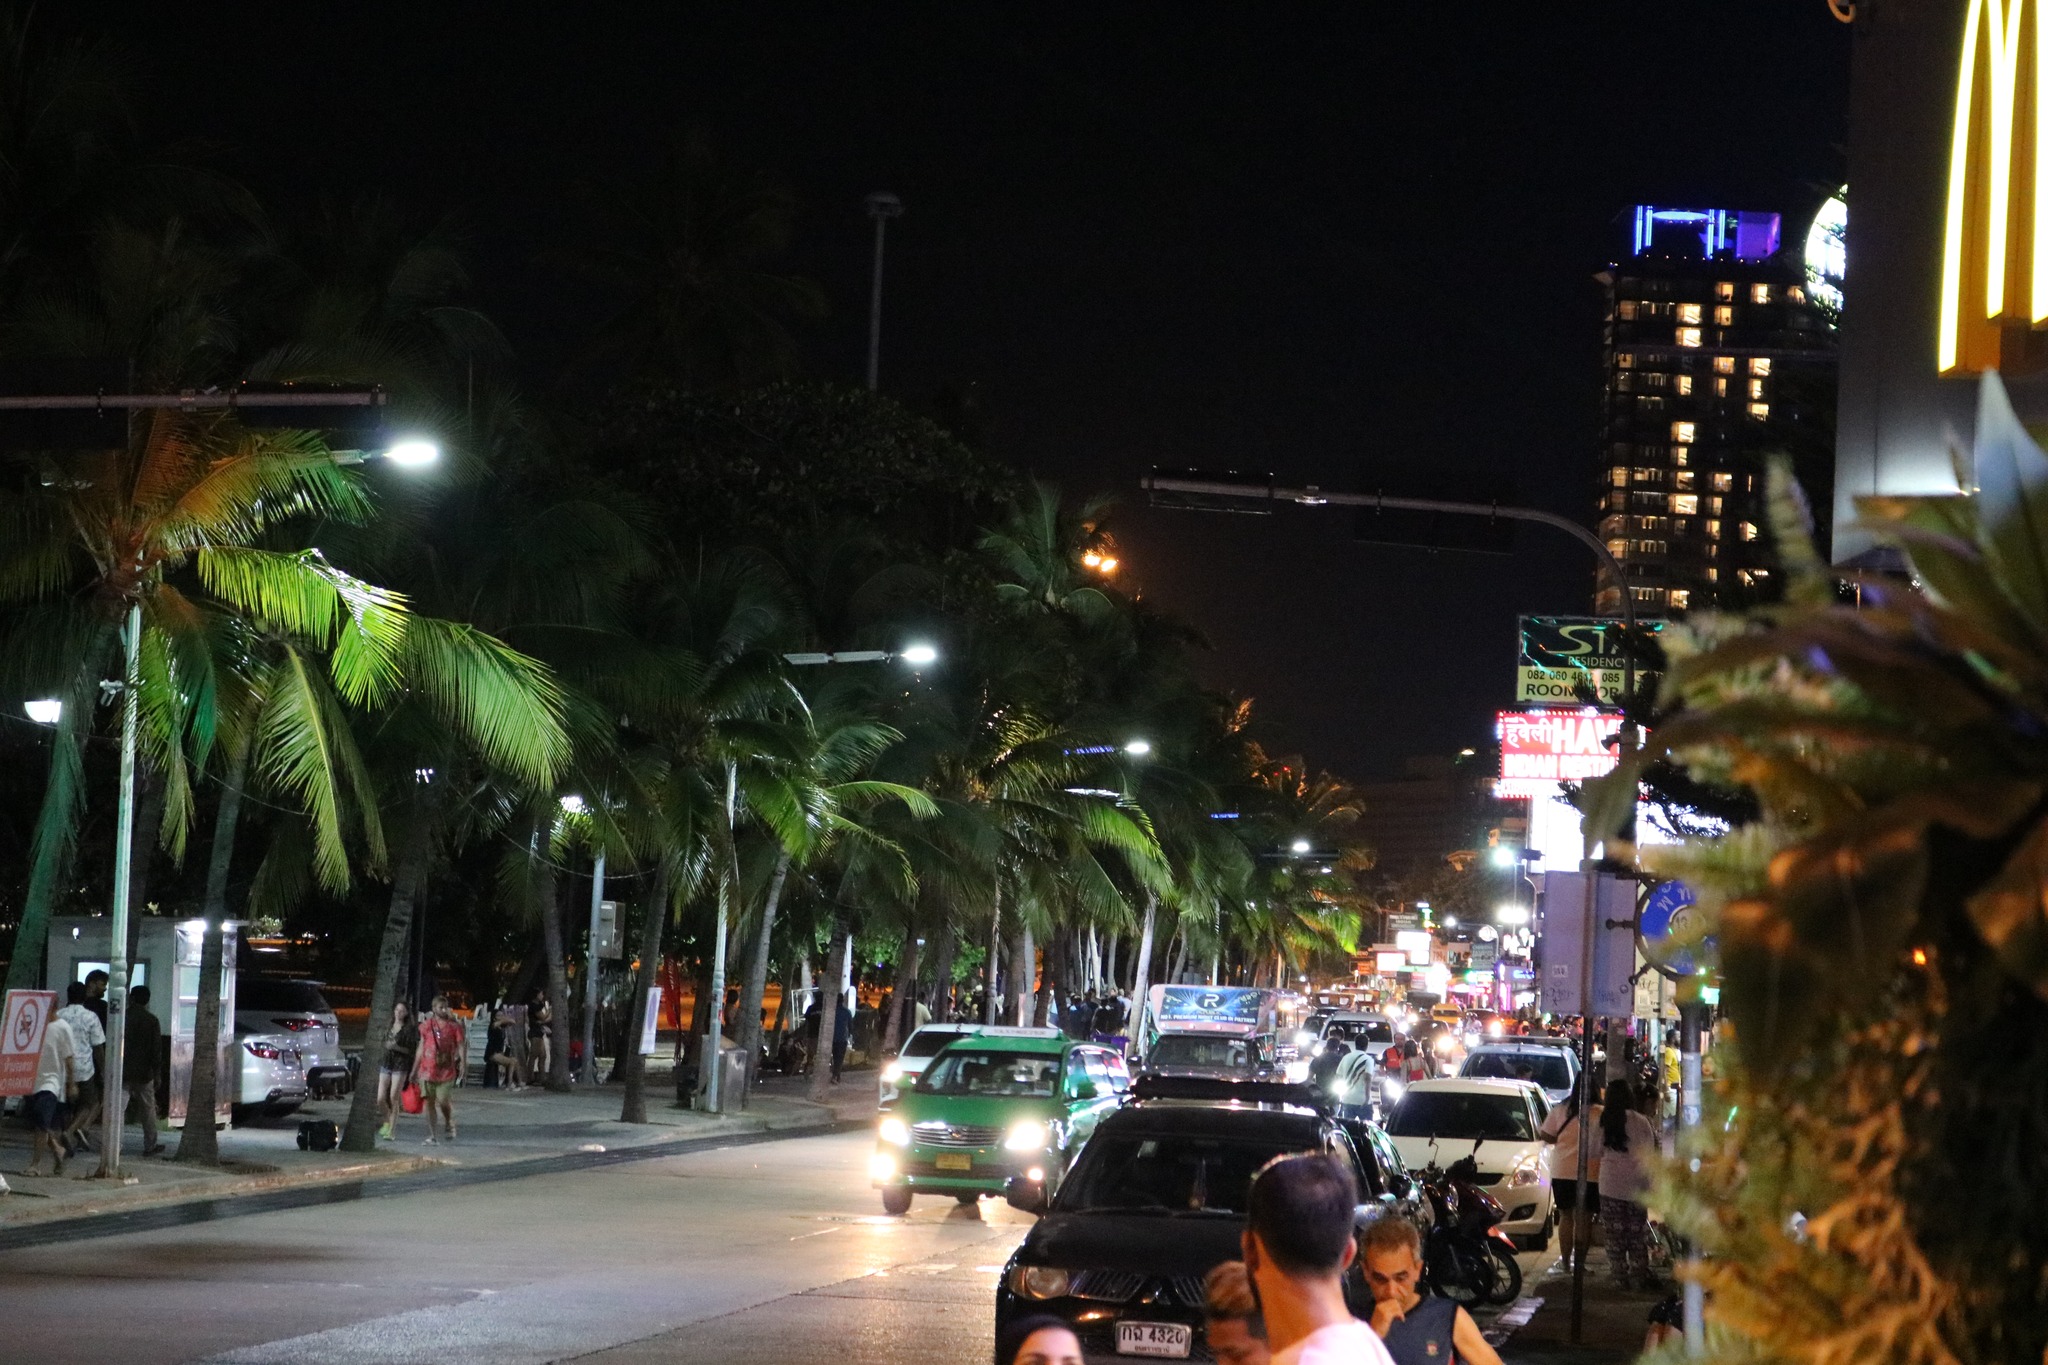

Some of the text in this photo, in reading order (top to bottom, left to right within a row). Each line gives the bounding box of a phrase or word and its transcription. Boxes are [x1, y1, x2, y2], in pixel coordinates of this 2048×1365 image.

[1527, 669, 1545, 680] 082
[1601, 673, 1620, 683] 085
[1503, 754, 1618, 779] INDIAN RESTA
[1203, 993, 1220, 1008] R
[1149, 1328, 1184, 1344] 4320
